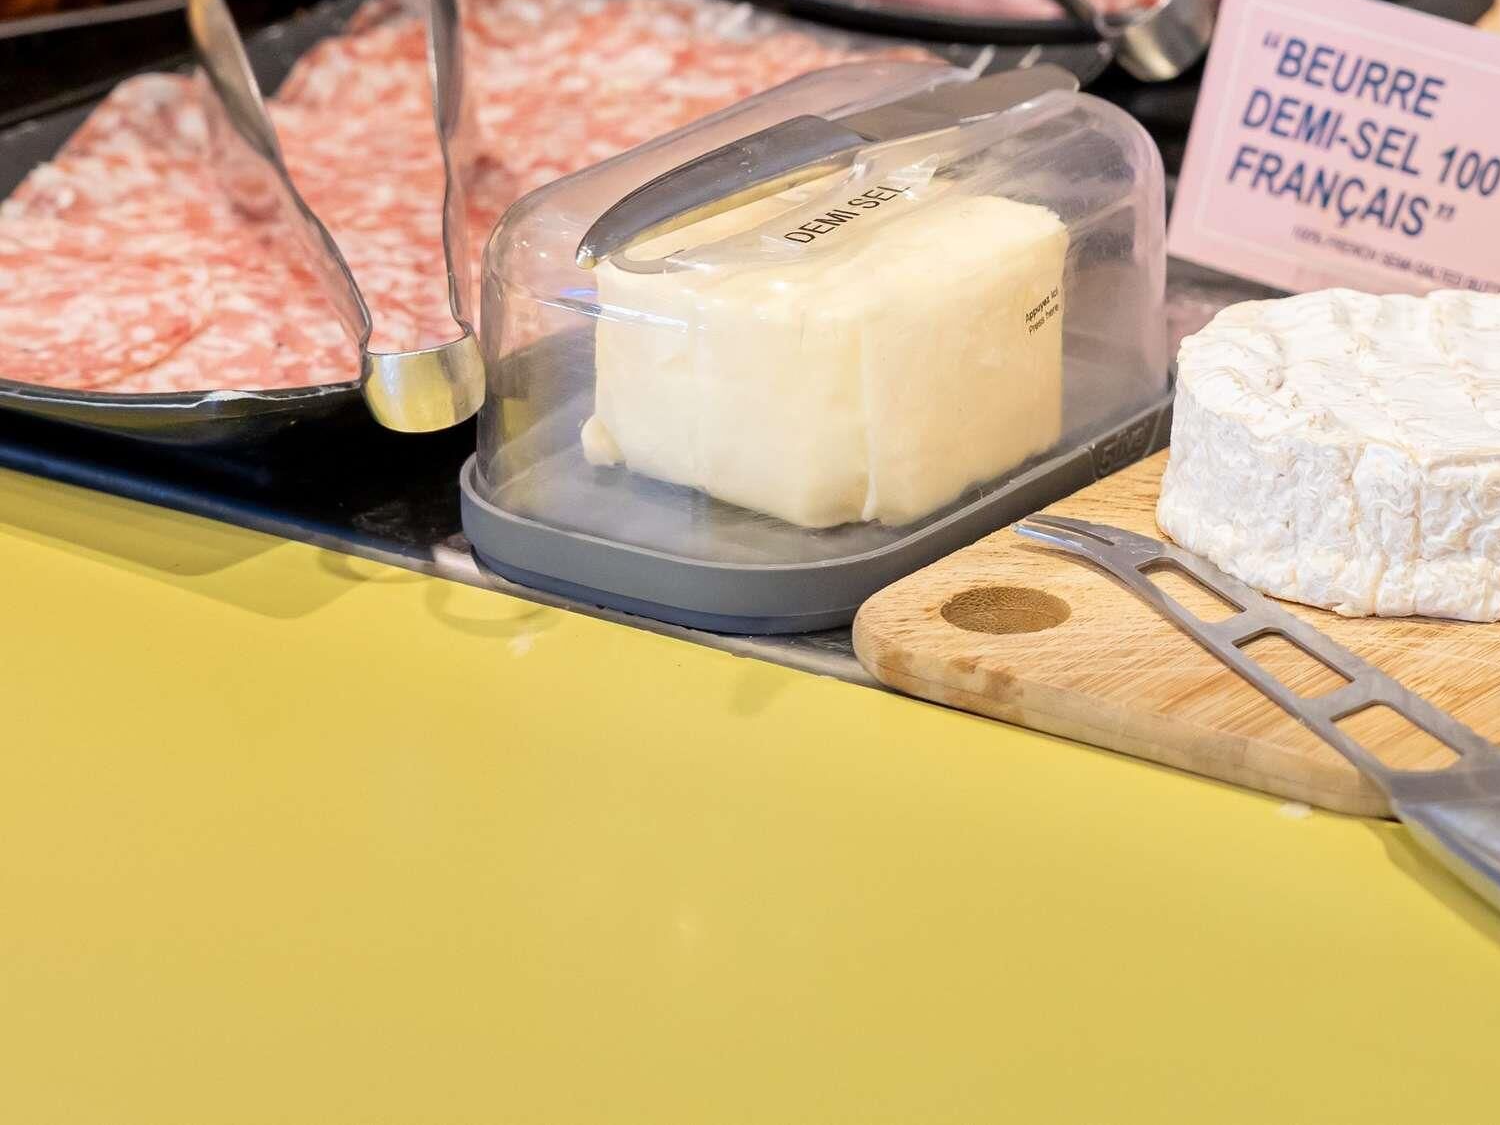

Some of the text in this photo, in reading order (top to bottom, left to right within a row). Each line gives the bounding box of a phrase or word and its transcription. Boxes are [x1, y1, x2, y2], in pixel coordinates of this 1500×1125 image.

[1263, 32, 1445, 119] “BEURRE
[1240, 88, 1422, 176] DEMI-SEL
[1438, 144, 1500, 197] 100
[783, 184, 912, 245] DEMI SEL
[1227, 144, 1456, 238] FRANÇAIS”
